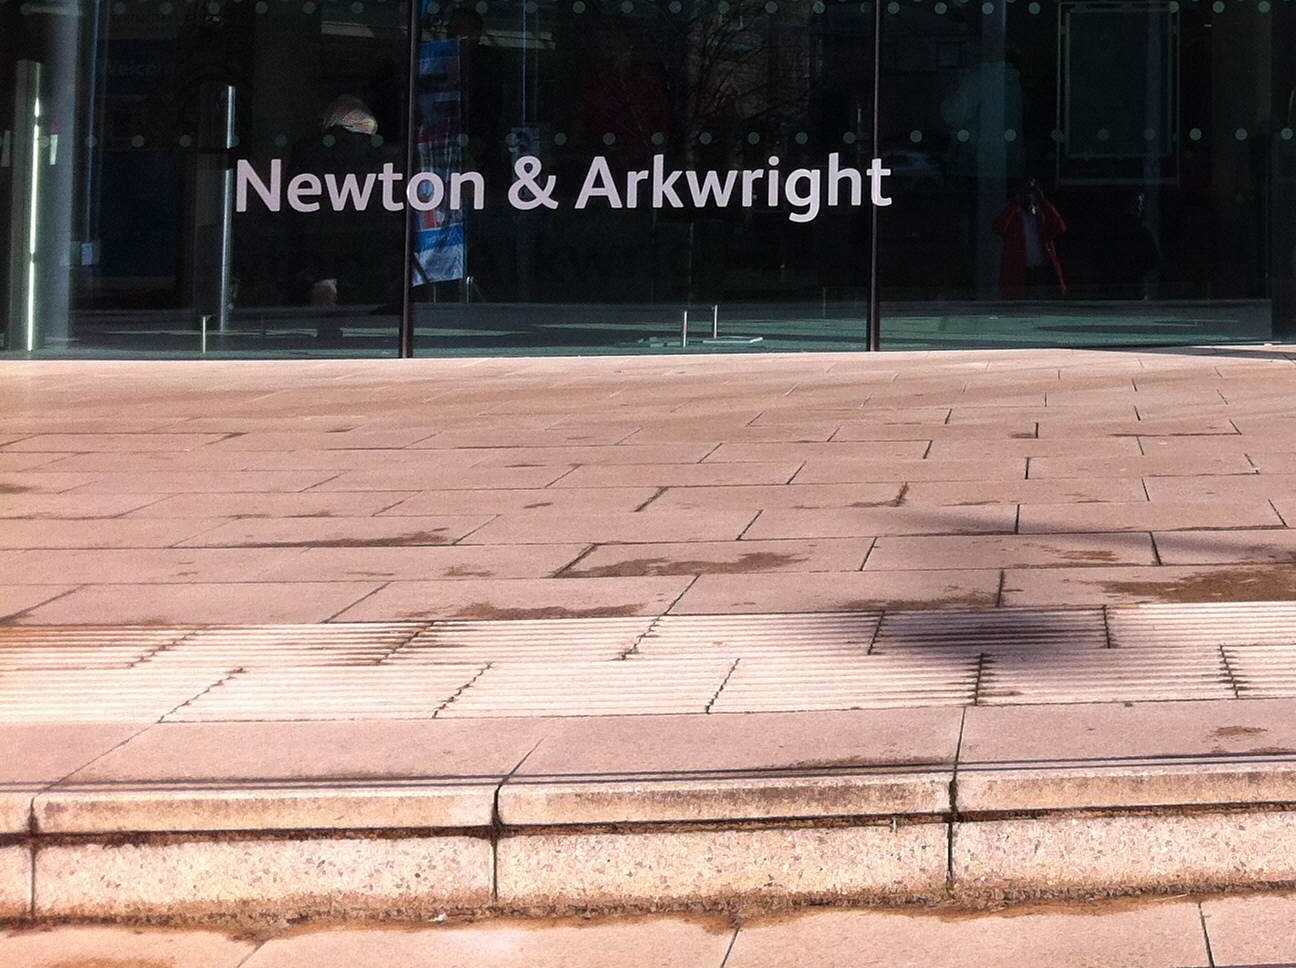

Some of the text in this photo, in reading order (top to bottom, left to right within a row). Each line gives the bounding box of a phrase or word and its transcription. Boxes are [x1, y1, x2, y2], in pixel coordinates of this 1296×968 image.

[235, 151, 894, 223] Newton & Arkwright
